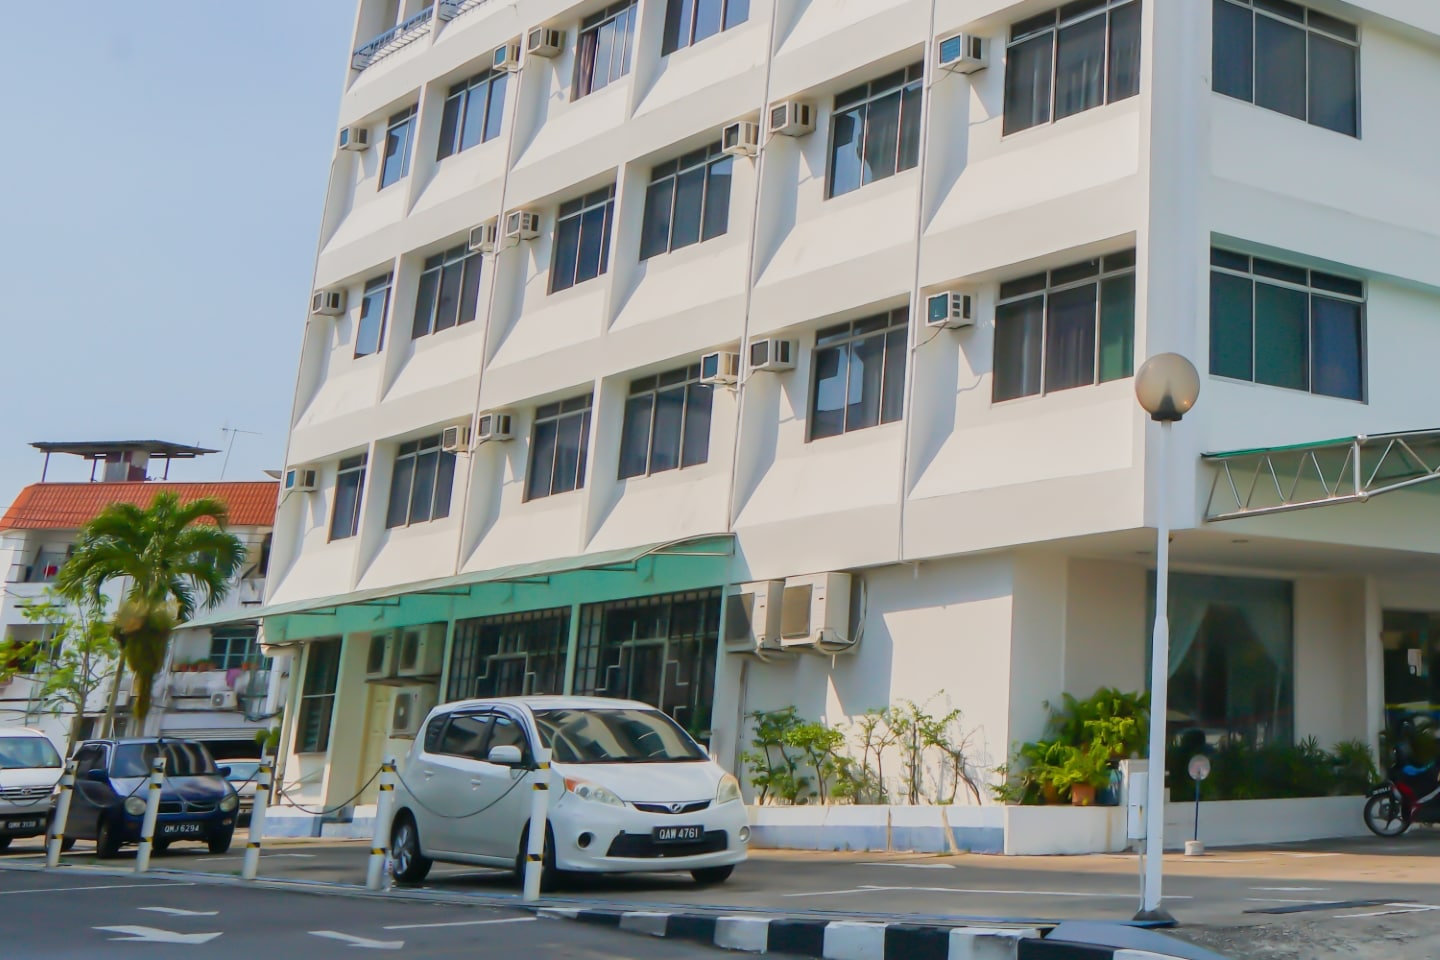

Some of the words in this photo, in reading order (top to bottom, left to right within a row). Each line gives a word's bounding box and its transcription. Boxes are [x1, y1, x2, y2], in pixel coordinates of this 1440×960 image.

[180, 824, 200, 833] 6294
[659, 829, 678, 840] QAW
[678, 827, 699, 839] 4761
